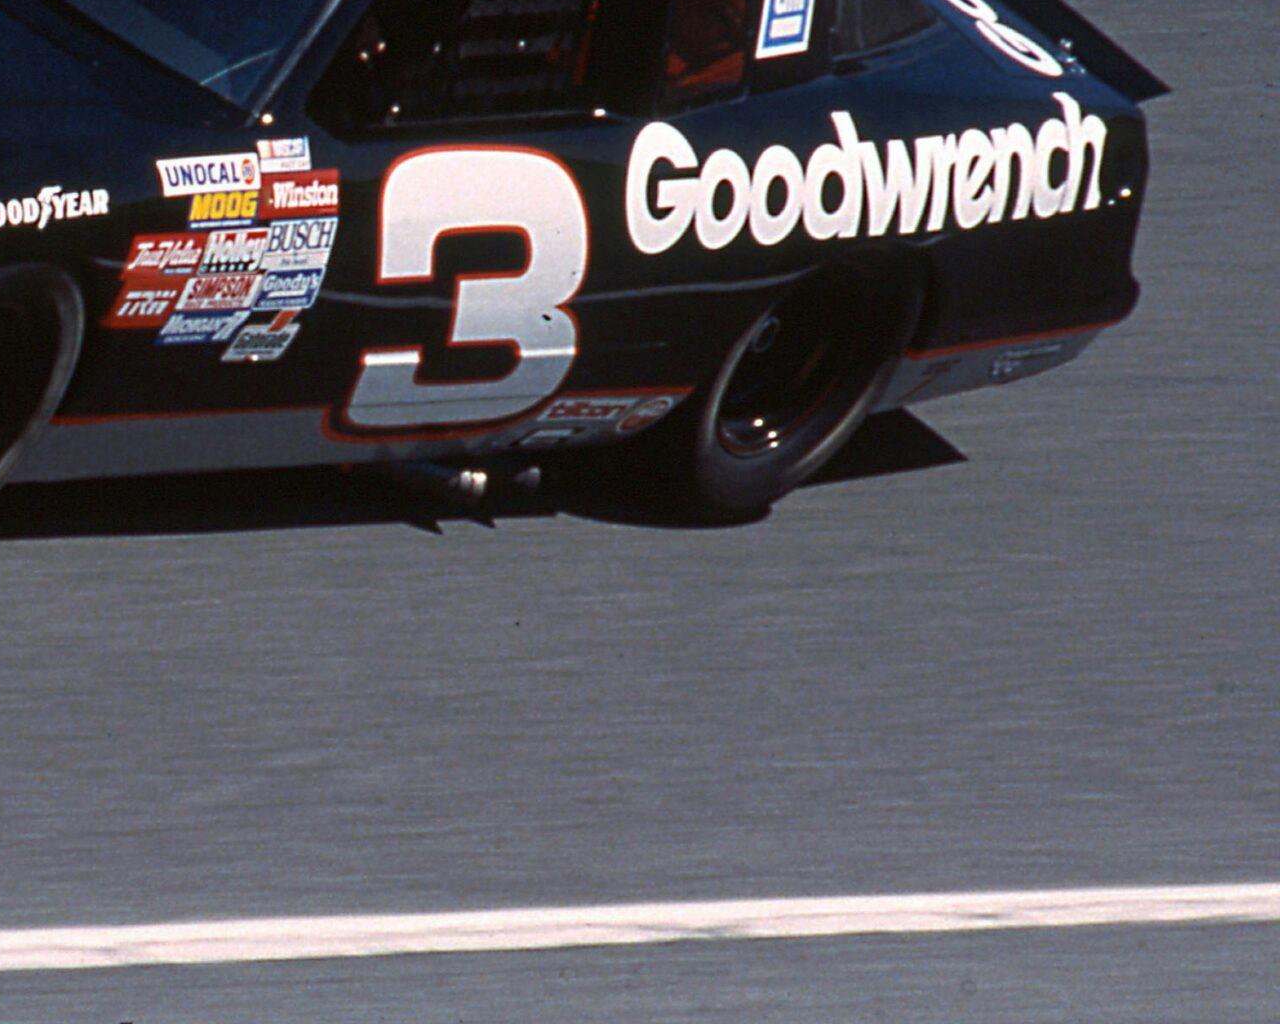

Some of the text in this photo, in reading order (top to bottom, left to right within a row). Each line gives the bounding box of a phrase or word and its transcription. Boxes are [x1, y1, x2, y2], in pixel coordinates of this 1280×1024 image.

[165, 161, 240, 187] UNOCAL
[625, 92, 1106, 255] Goodwrench
[189, 191, 258, 220] MOOG
[271, 180, 338, 208] Winston
[267, 220, 335, 252] BUSCH
[345, 143, 591, 429] 3
[117, 290, 177, 316] TRW
